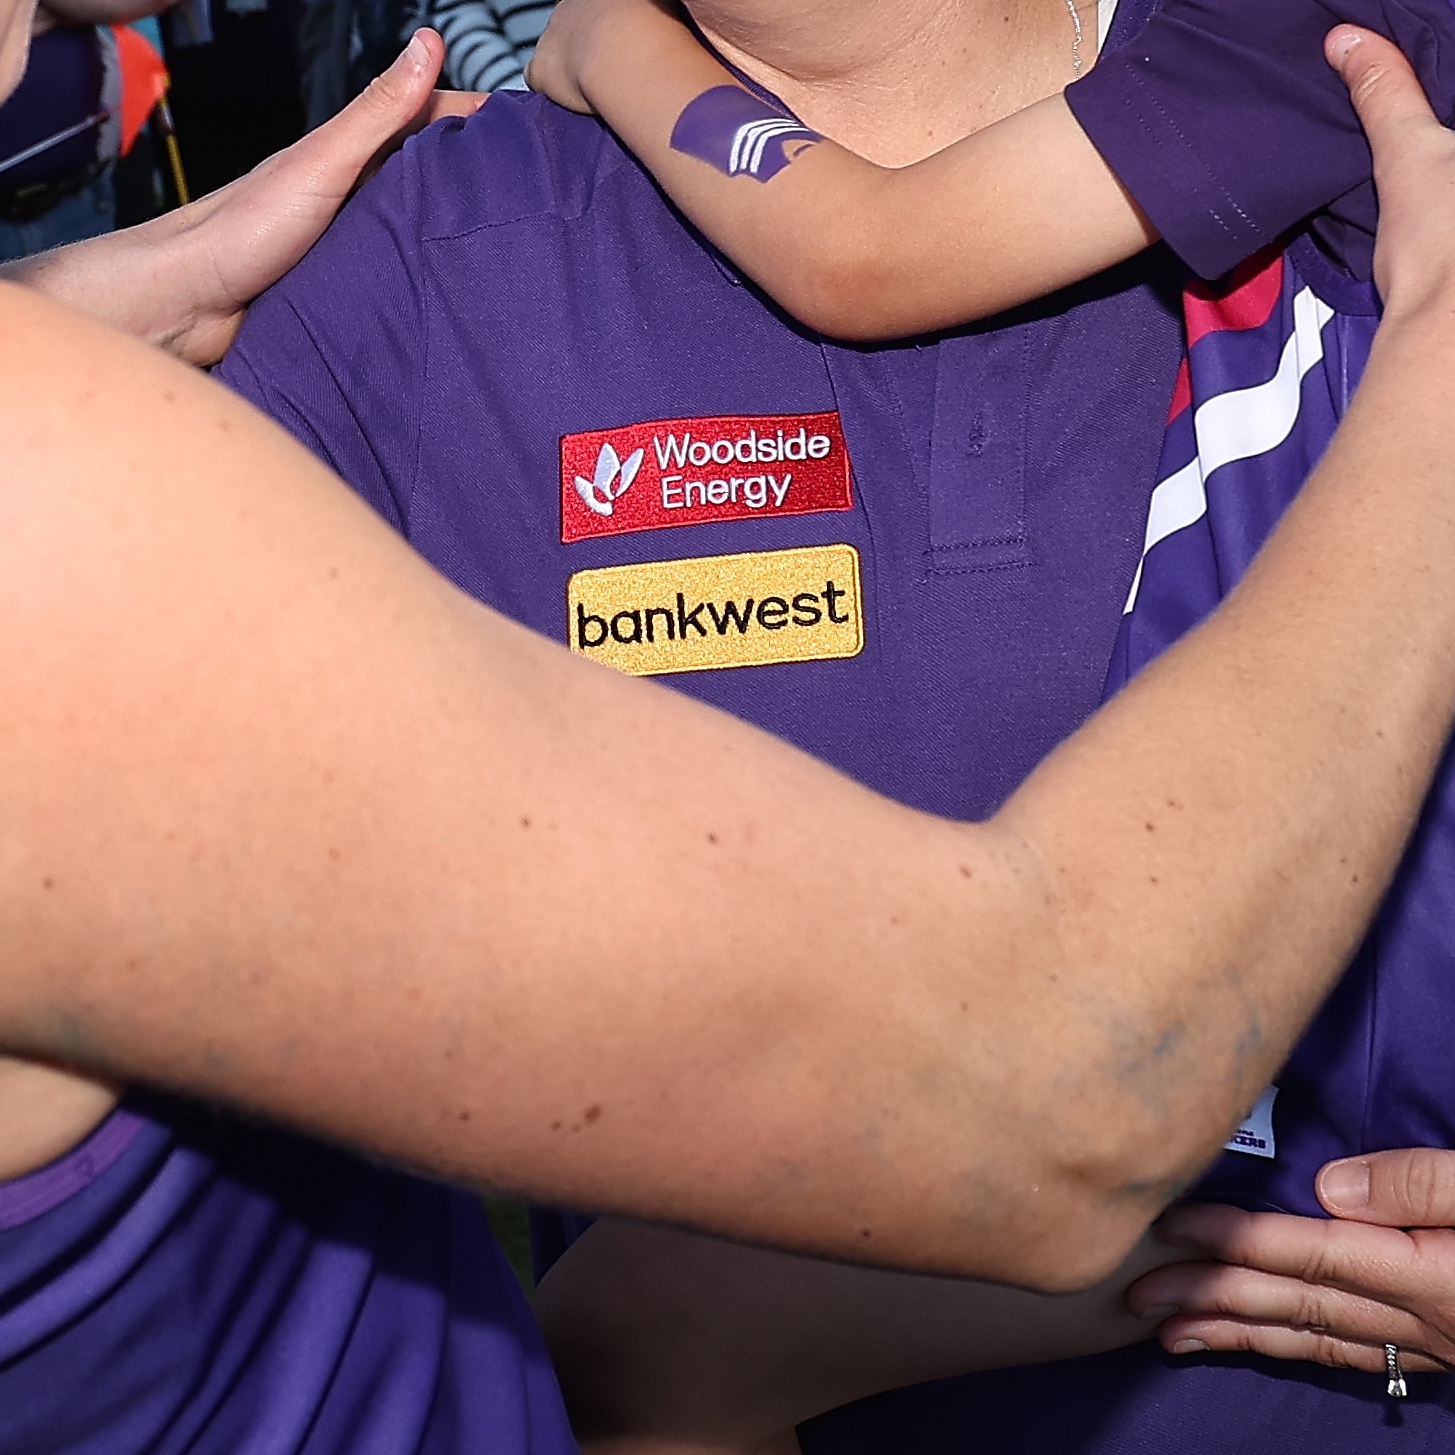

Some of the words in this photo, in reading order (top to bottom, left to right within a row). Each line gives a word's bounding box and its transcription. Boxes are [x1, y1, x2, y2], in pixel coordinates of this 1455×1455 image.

[653, 427, 832, 470] Woodside
[660, 473, 793, 510] Energy
[576, 580, 849, 649] bankwest
